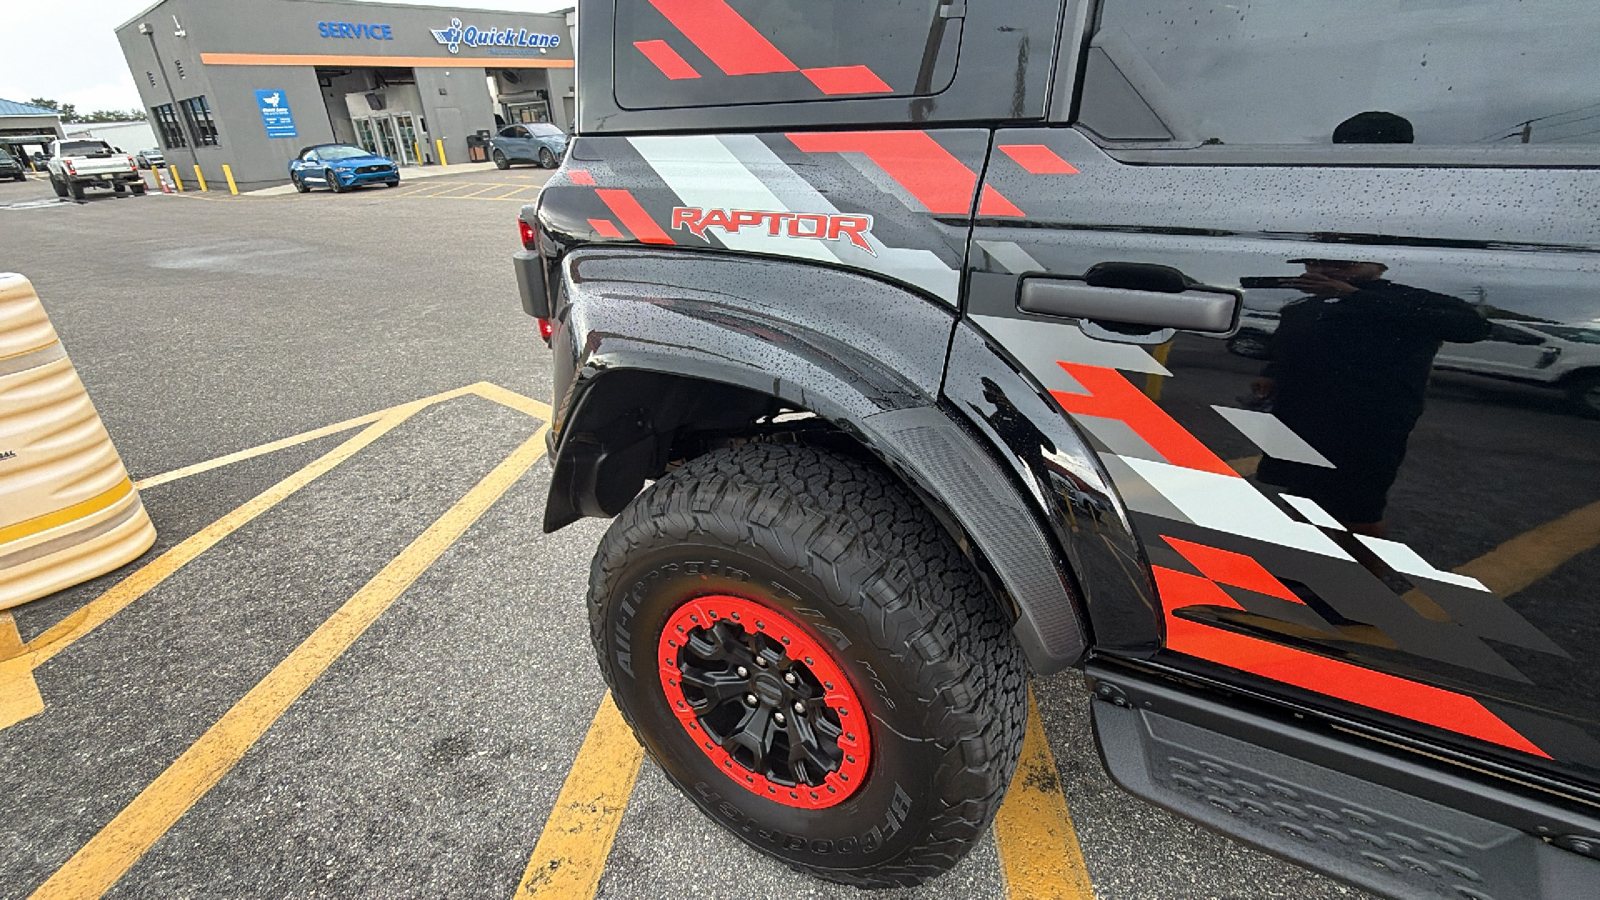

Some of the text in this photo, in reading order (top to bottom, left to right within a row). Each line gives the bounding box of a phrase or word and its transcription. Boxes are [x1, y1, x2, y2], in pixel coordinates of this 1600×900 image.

[317, 21, 393, 40] SERVICE
[462, 25, 560, 48] Quick Lane
[671, 206, 878, 258] RAPTOR
